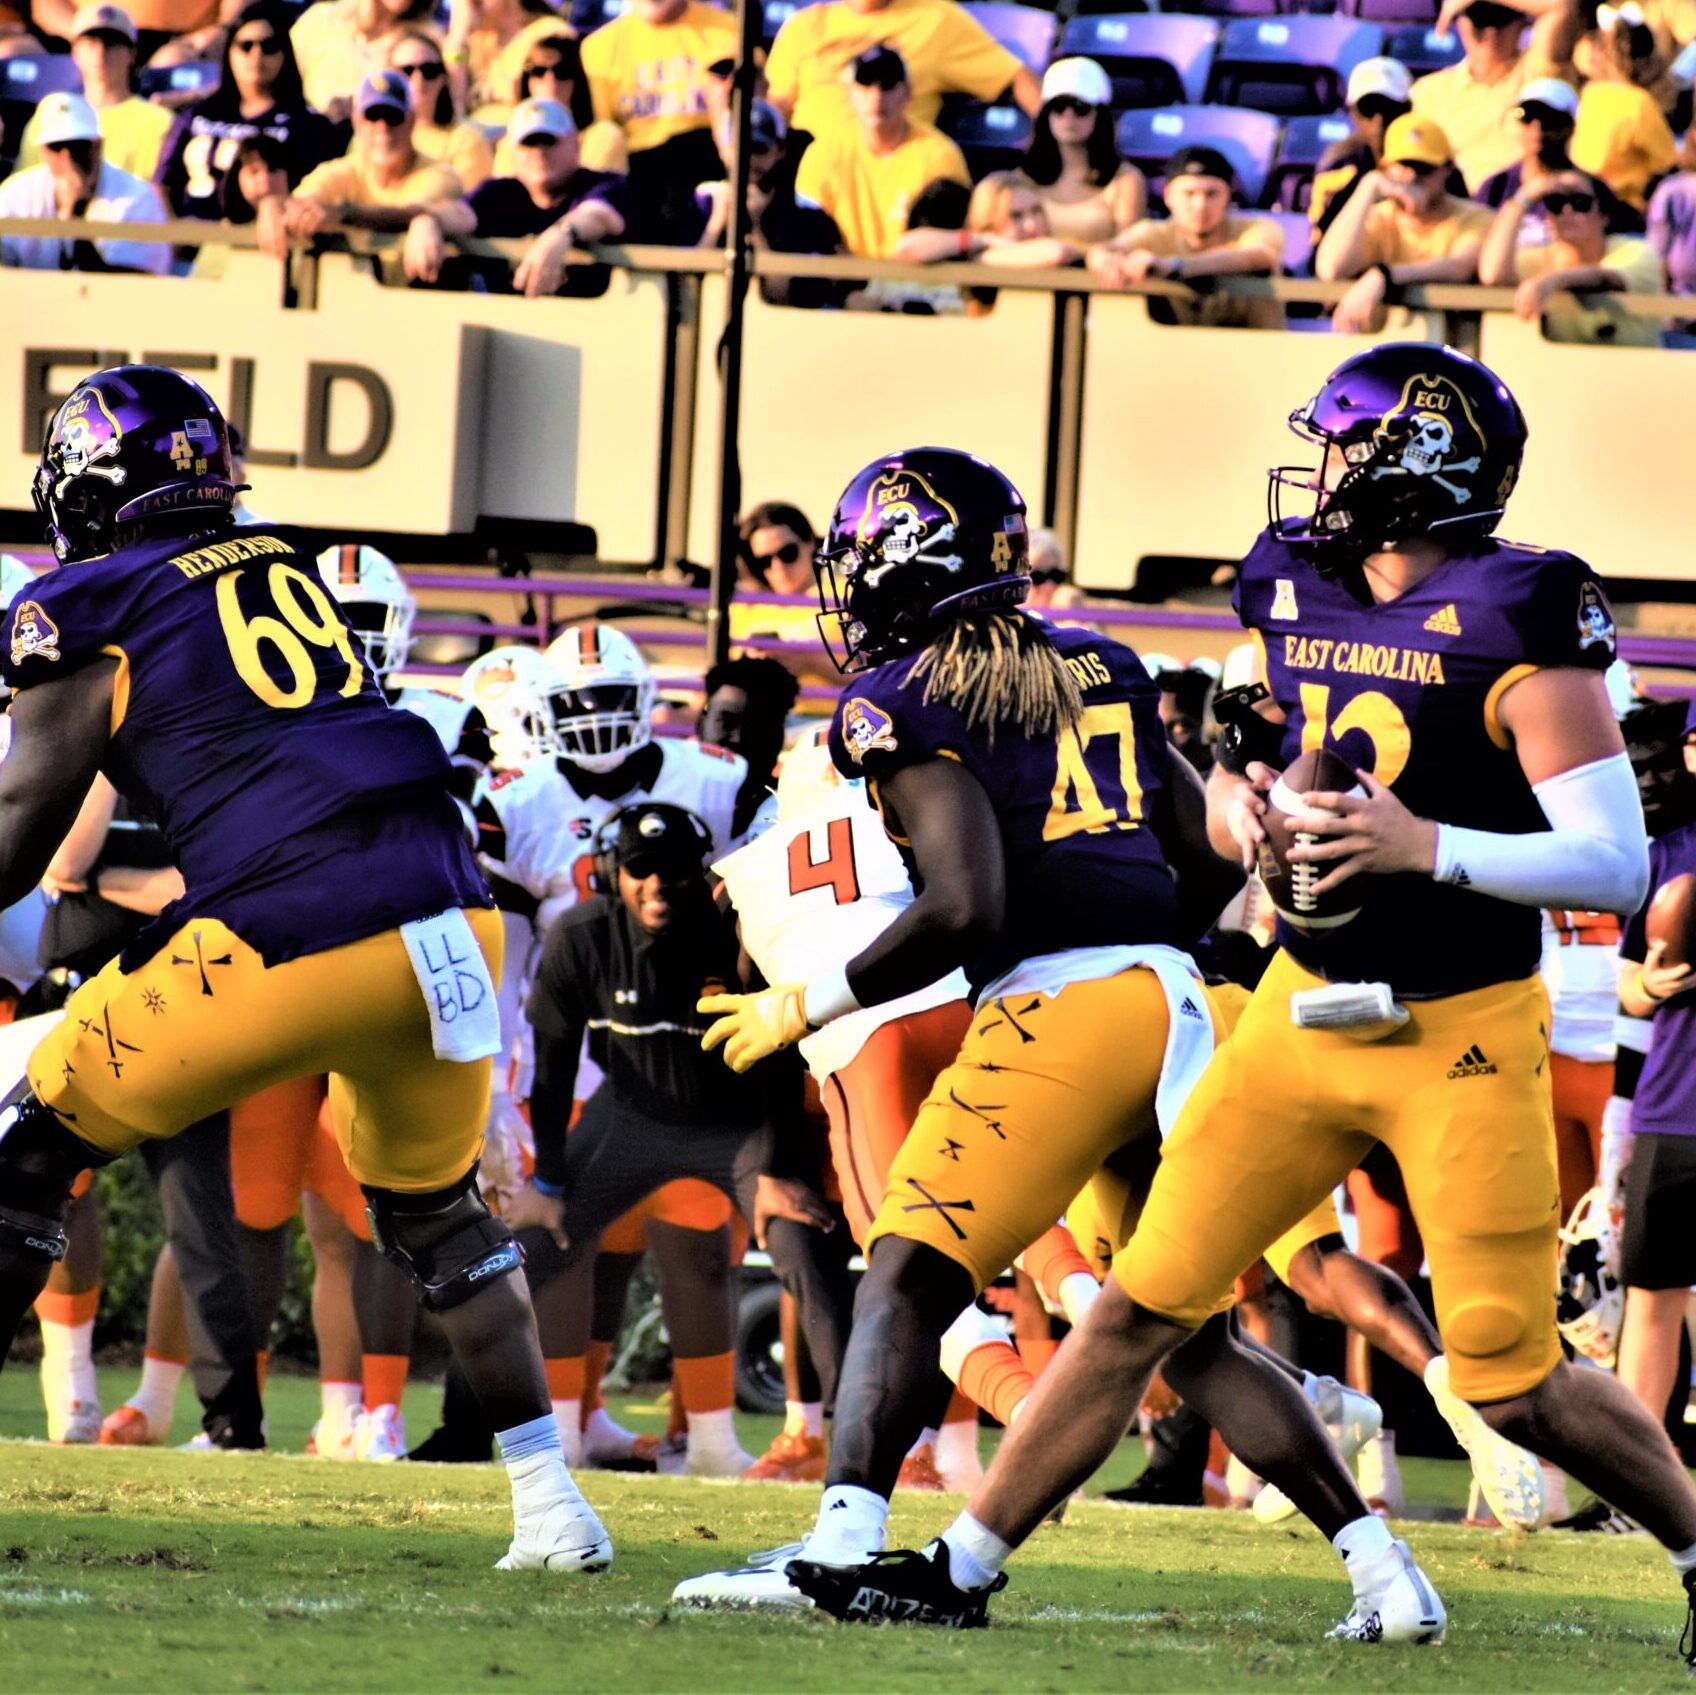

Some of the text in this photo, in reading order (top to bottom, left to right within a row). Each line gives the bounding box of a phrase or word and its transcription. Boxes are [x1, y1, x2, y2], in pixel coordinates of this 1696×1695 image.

[22, 347, 396, 471] FLD
[1414, 390, 1451, 411] ECU
[143, 491, 180, 511] EAST
[877, 482, 910, 505] ECU
[168, 535, 296, 579] HENDERSON
[215, 561, 364, 709] 69
[1066, 651, 1112, 691] RIS
[1284, 635, 1446, 686] EAST CAROLINA
[1042, 702, 1144, 842] 47
[787, 816, 862, 906] 4
[419, 933, 470, 974] LL
[434, 969, 486, 1023] BD
[1446, 1063, 1499, 1080] adidas
